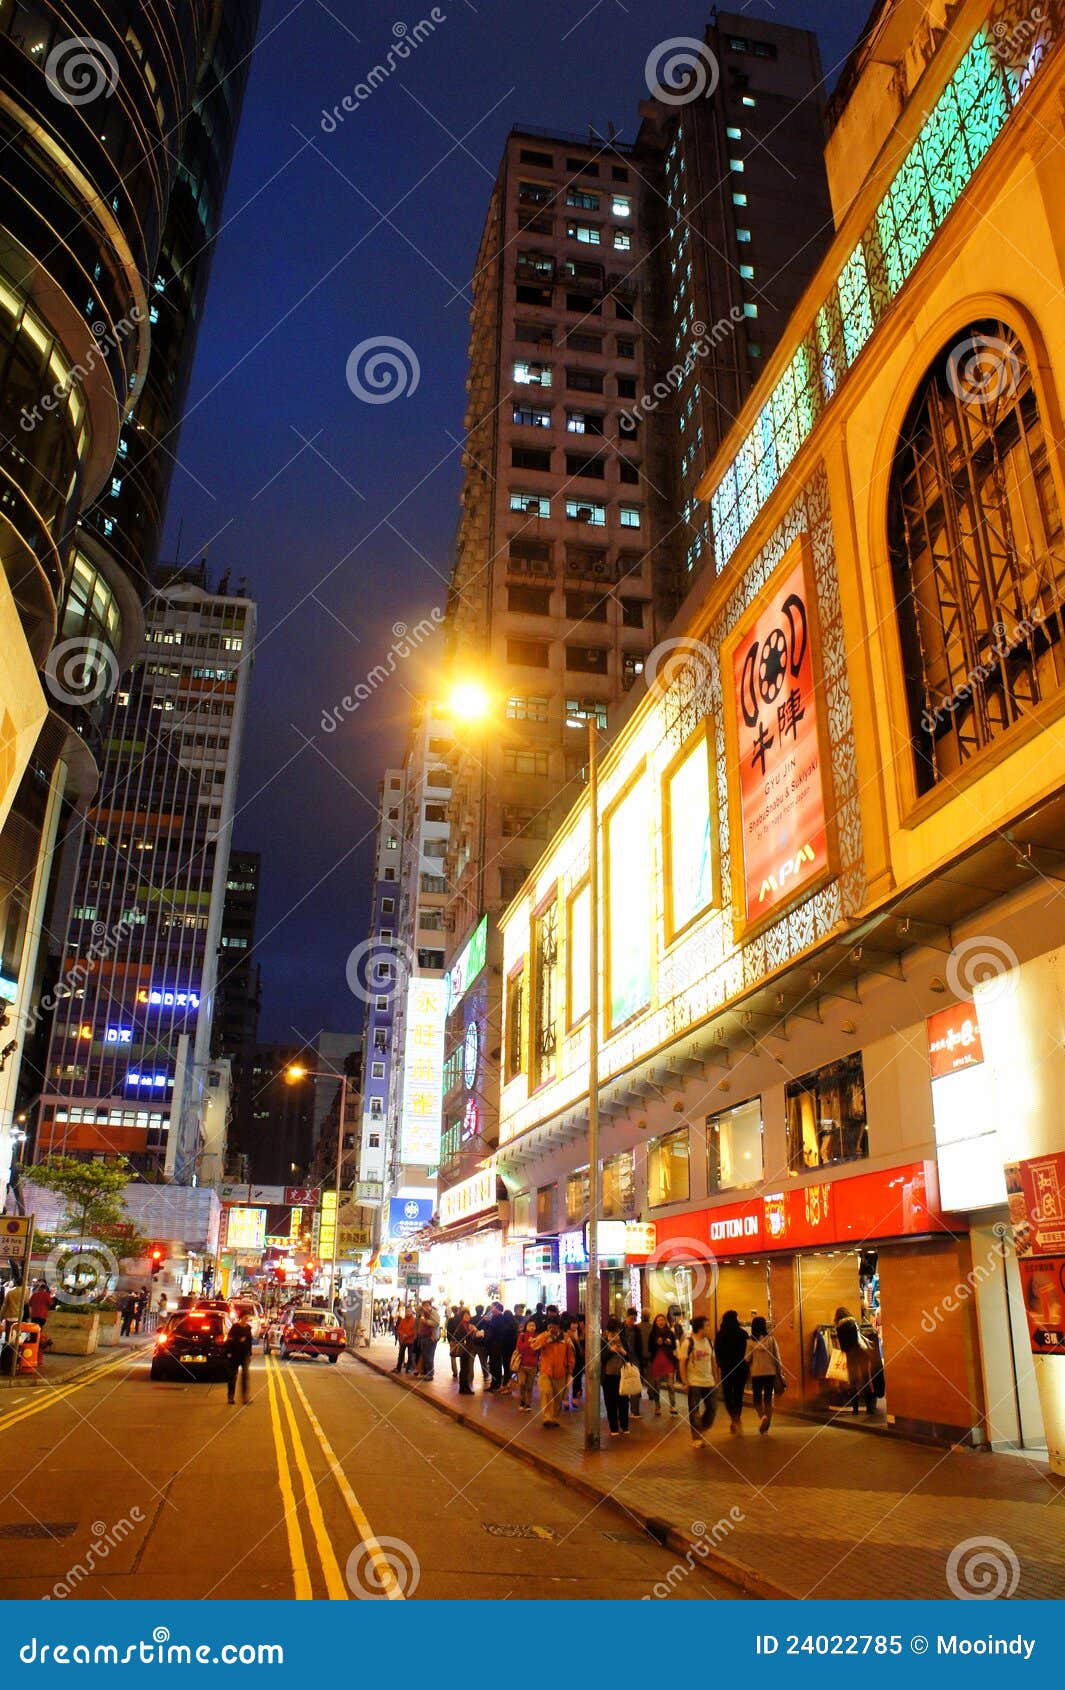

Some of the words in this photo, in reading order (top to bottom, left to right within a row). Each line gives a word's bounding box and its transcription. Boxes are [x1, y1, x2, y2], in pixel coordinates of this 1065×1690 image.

[751, 688, 805, 776] 牛陣
[764, 775, 781, 795] GYU
[783, 756, 796, 778] JIN
[710, 1217, 743, 1241] COTTON
[743, 1215, 758, 1236] ON
